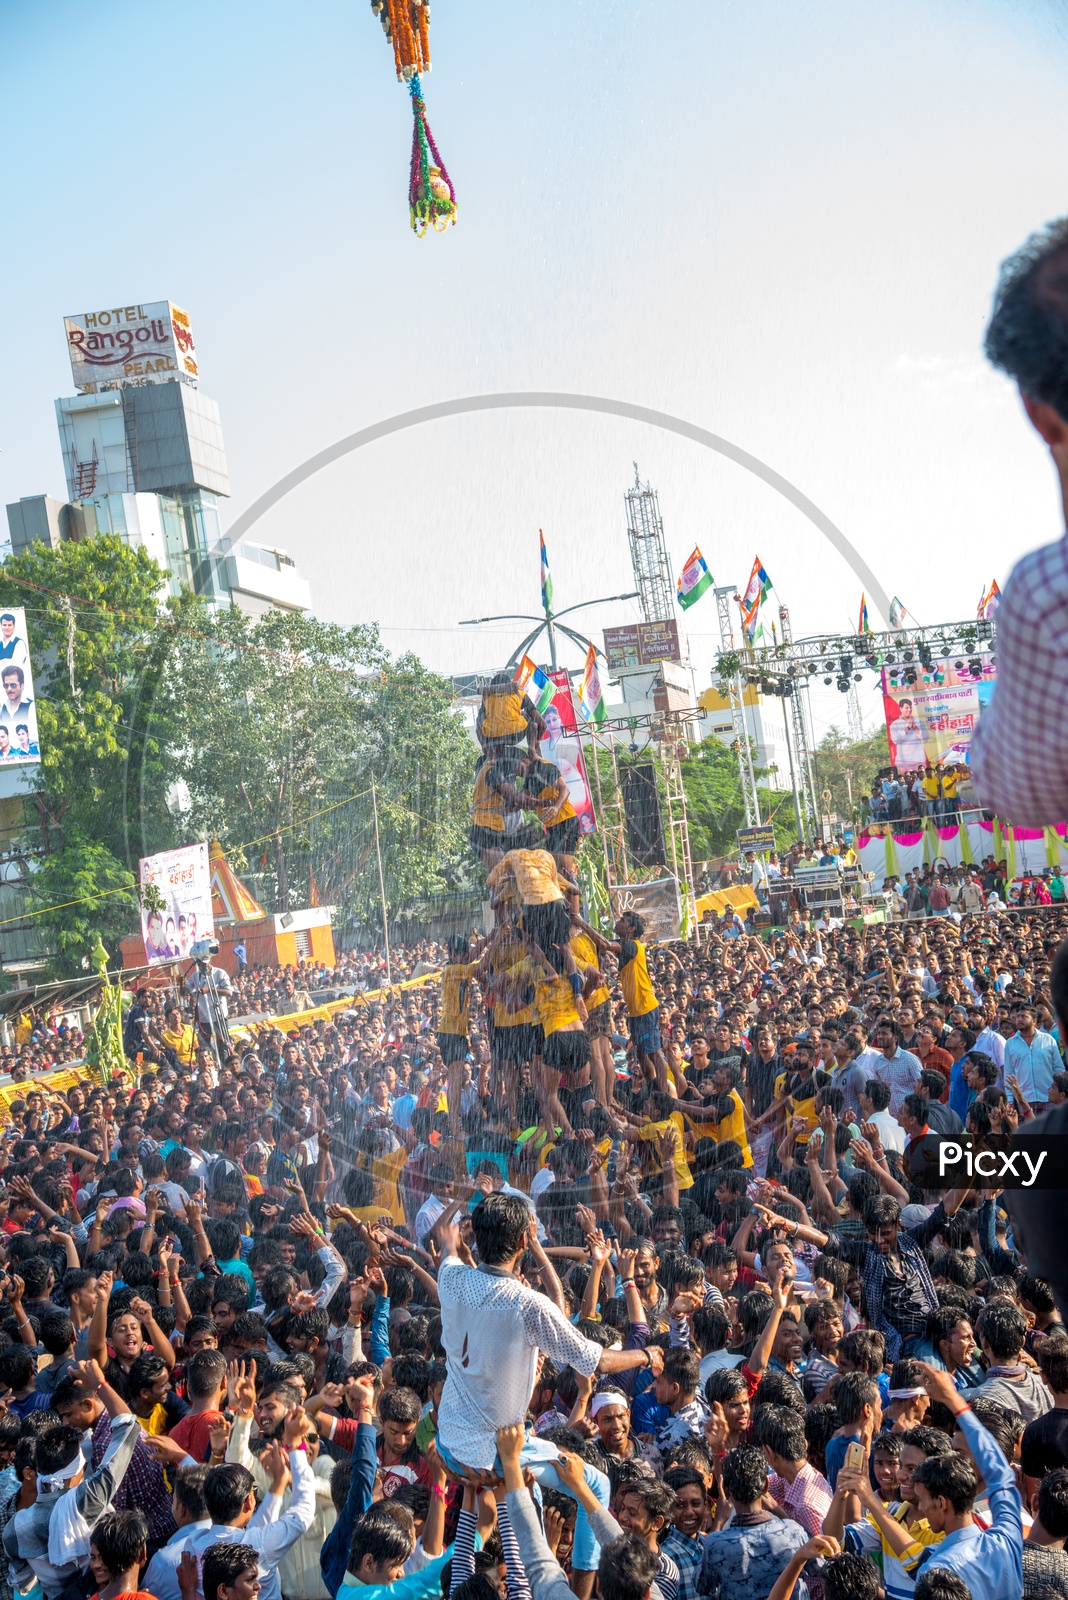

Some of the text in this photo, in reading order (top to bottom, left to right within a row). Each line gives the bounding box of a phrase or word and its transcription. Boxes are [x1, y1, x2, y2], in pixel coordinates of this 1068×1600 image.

[84, 305, 148, 328] HOTEL
[69, 319, 169, 366] Rangoli
[124, 357, 175, 377] PEARL
[618, 634, 630, 642] Royal
[913, 696, 926, 706] युवा
[926, 692, 957, 702] स्वाभिमान
